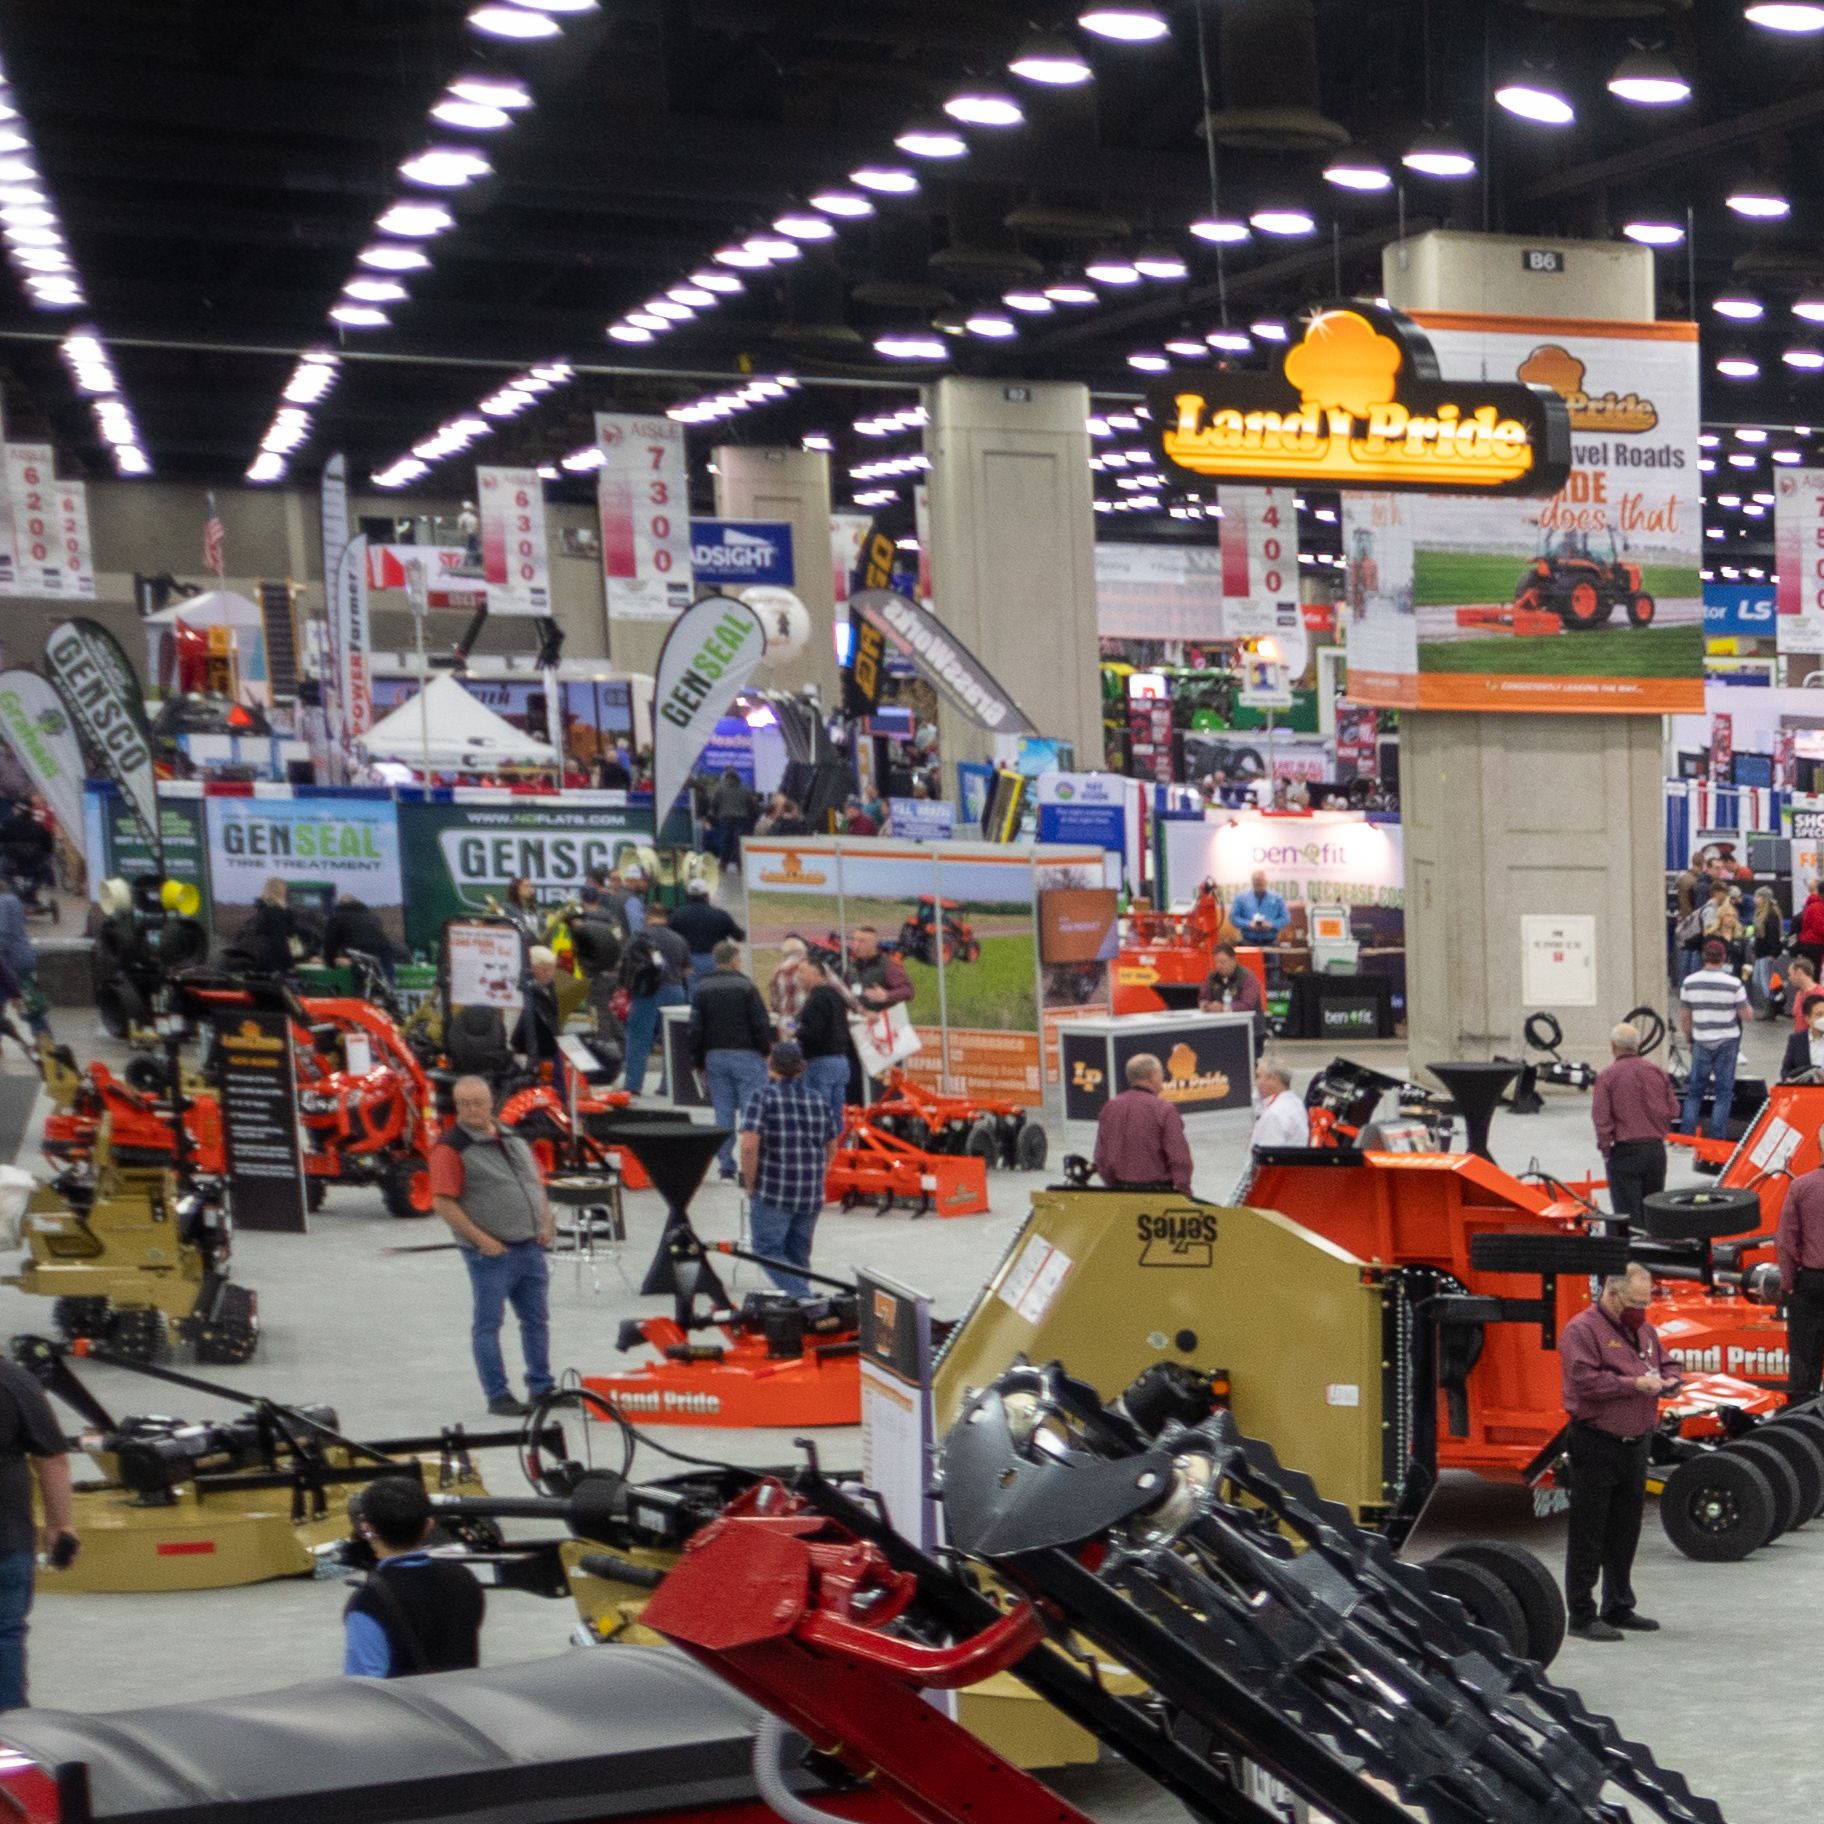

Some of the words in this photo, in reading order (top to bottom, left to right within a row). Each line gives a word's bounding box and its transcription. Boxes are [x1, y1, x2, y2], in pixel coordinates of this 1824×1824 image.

[1528, 251, 1556, 271] B6
[1171, 393, 1328, 452] Land
[1365, 402, 1529, 460] Pride
[1614, 443, 1685, 469] Roads
[1738, 599, 1773, 621] LS
[660, 612, 755, 729] GENSEAL
[223, 822, 382, 859] GENSEAL
[1137, 1213, 1218, 1245] Series
[1669, 1342, 1723, 1372] and
[664, 1391, 720, 1413] Pride
